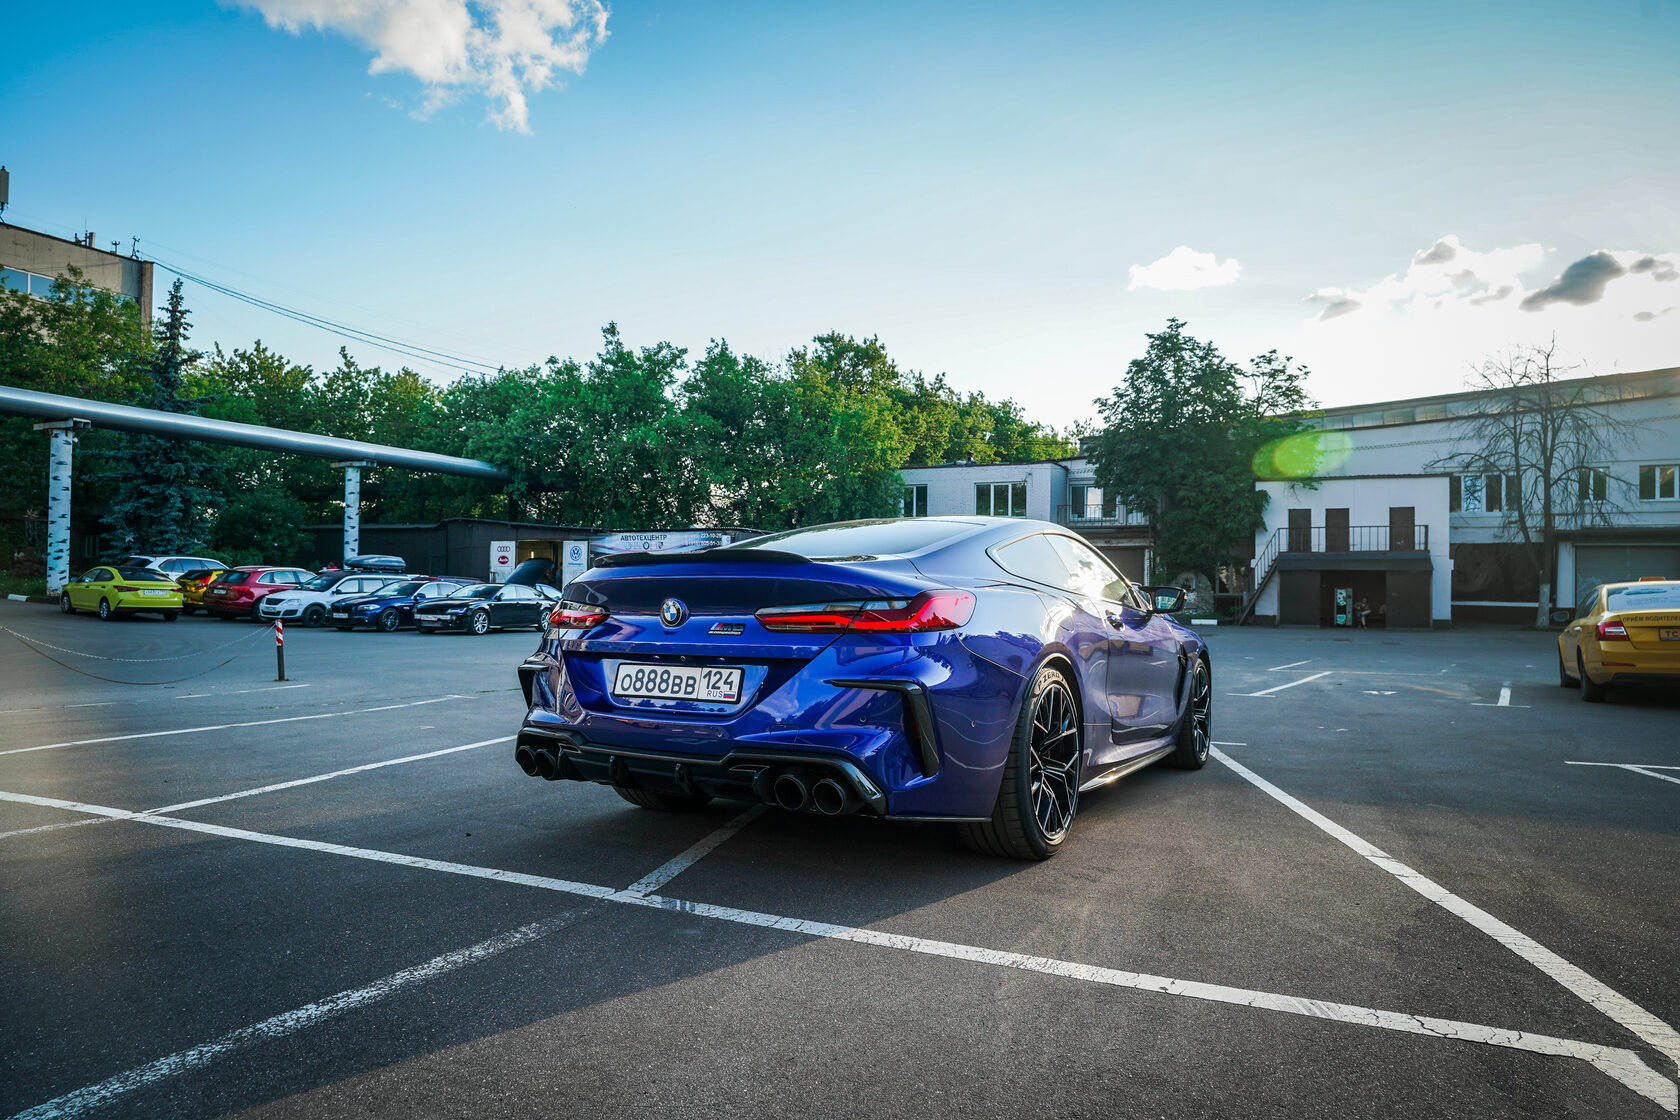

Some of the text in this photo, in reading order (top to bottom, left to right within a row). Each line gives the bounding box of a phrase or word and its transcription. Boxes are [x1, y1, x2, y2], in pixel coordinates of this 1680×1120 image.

[703, 670, 734, 691] 124
[1042, 671, 1060, 683] ZERO
[706, 690, 723, 698] RUS
